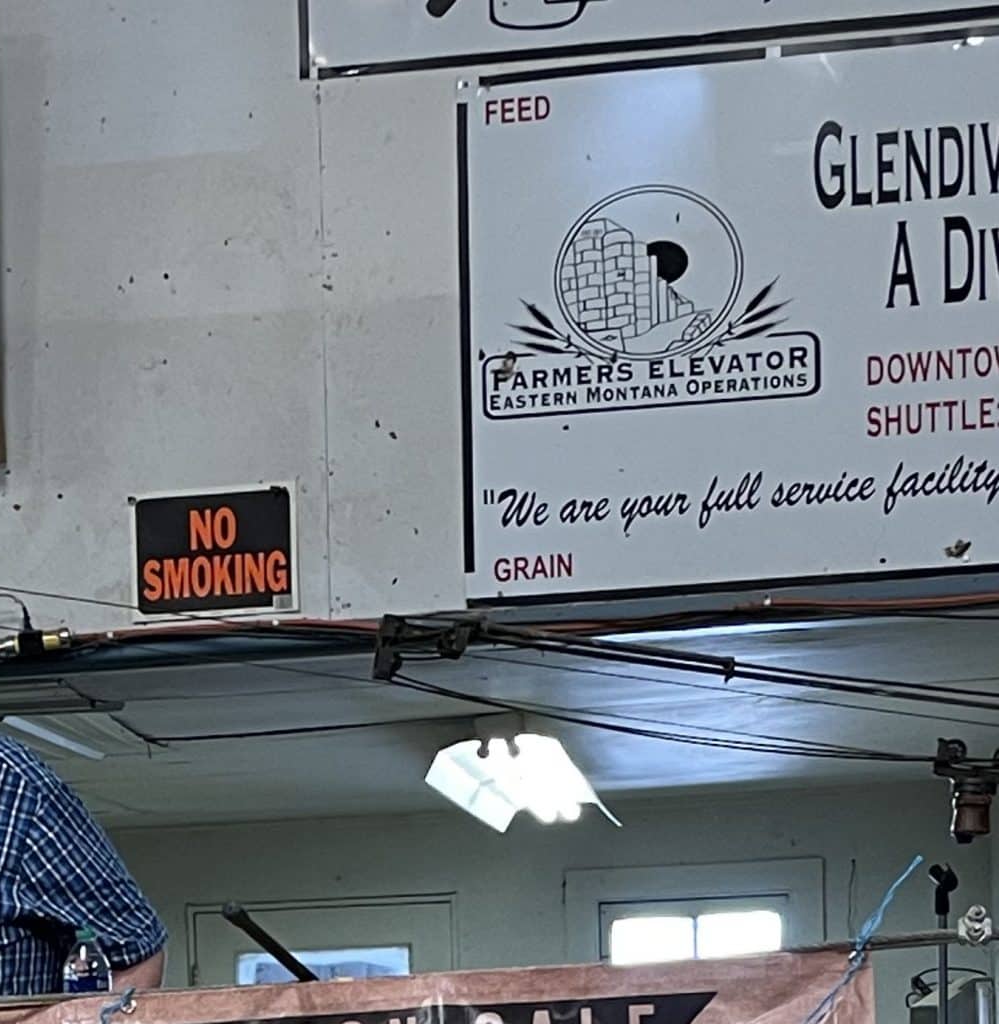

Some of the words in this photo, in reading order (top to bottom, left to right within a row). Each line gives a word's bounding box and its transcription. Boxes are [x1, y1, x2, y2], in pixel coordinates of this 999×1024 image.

[484, 95, 551, 125] FEED
[885, 220, 920, 309] A
[490, 360, 633, 393] FARMERS
[648, 346, 810, 381] ELEVATOR
[866, 345, 999, 386] DOWNTO
[489, 391, 578, 411] EASTERN
[586, 381, 679, 403] MONTANA
[686, 372, 809, 396] OPERATIONS
[866, 397, 999, 438] SHUTTLE
[559, 497, 610, 523] are
[620, 489, 691, 532] your
[698, 471, 764, 530] full
[770, 472, 876, 507] service
[883, 454, 999, 516] facility
[189, 506, 237, 551] NO
[143, 550, 288, 601] SMOKING
[493, 552, 573, 582] GRAIN
